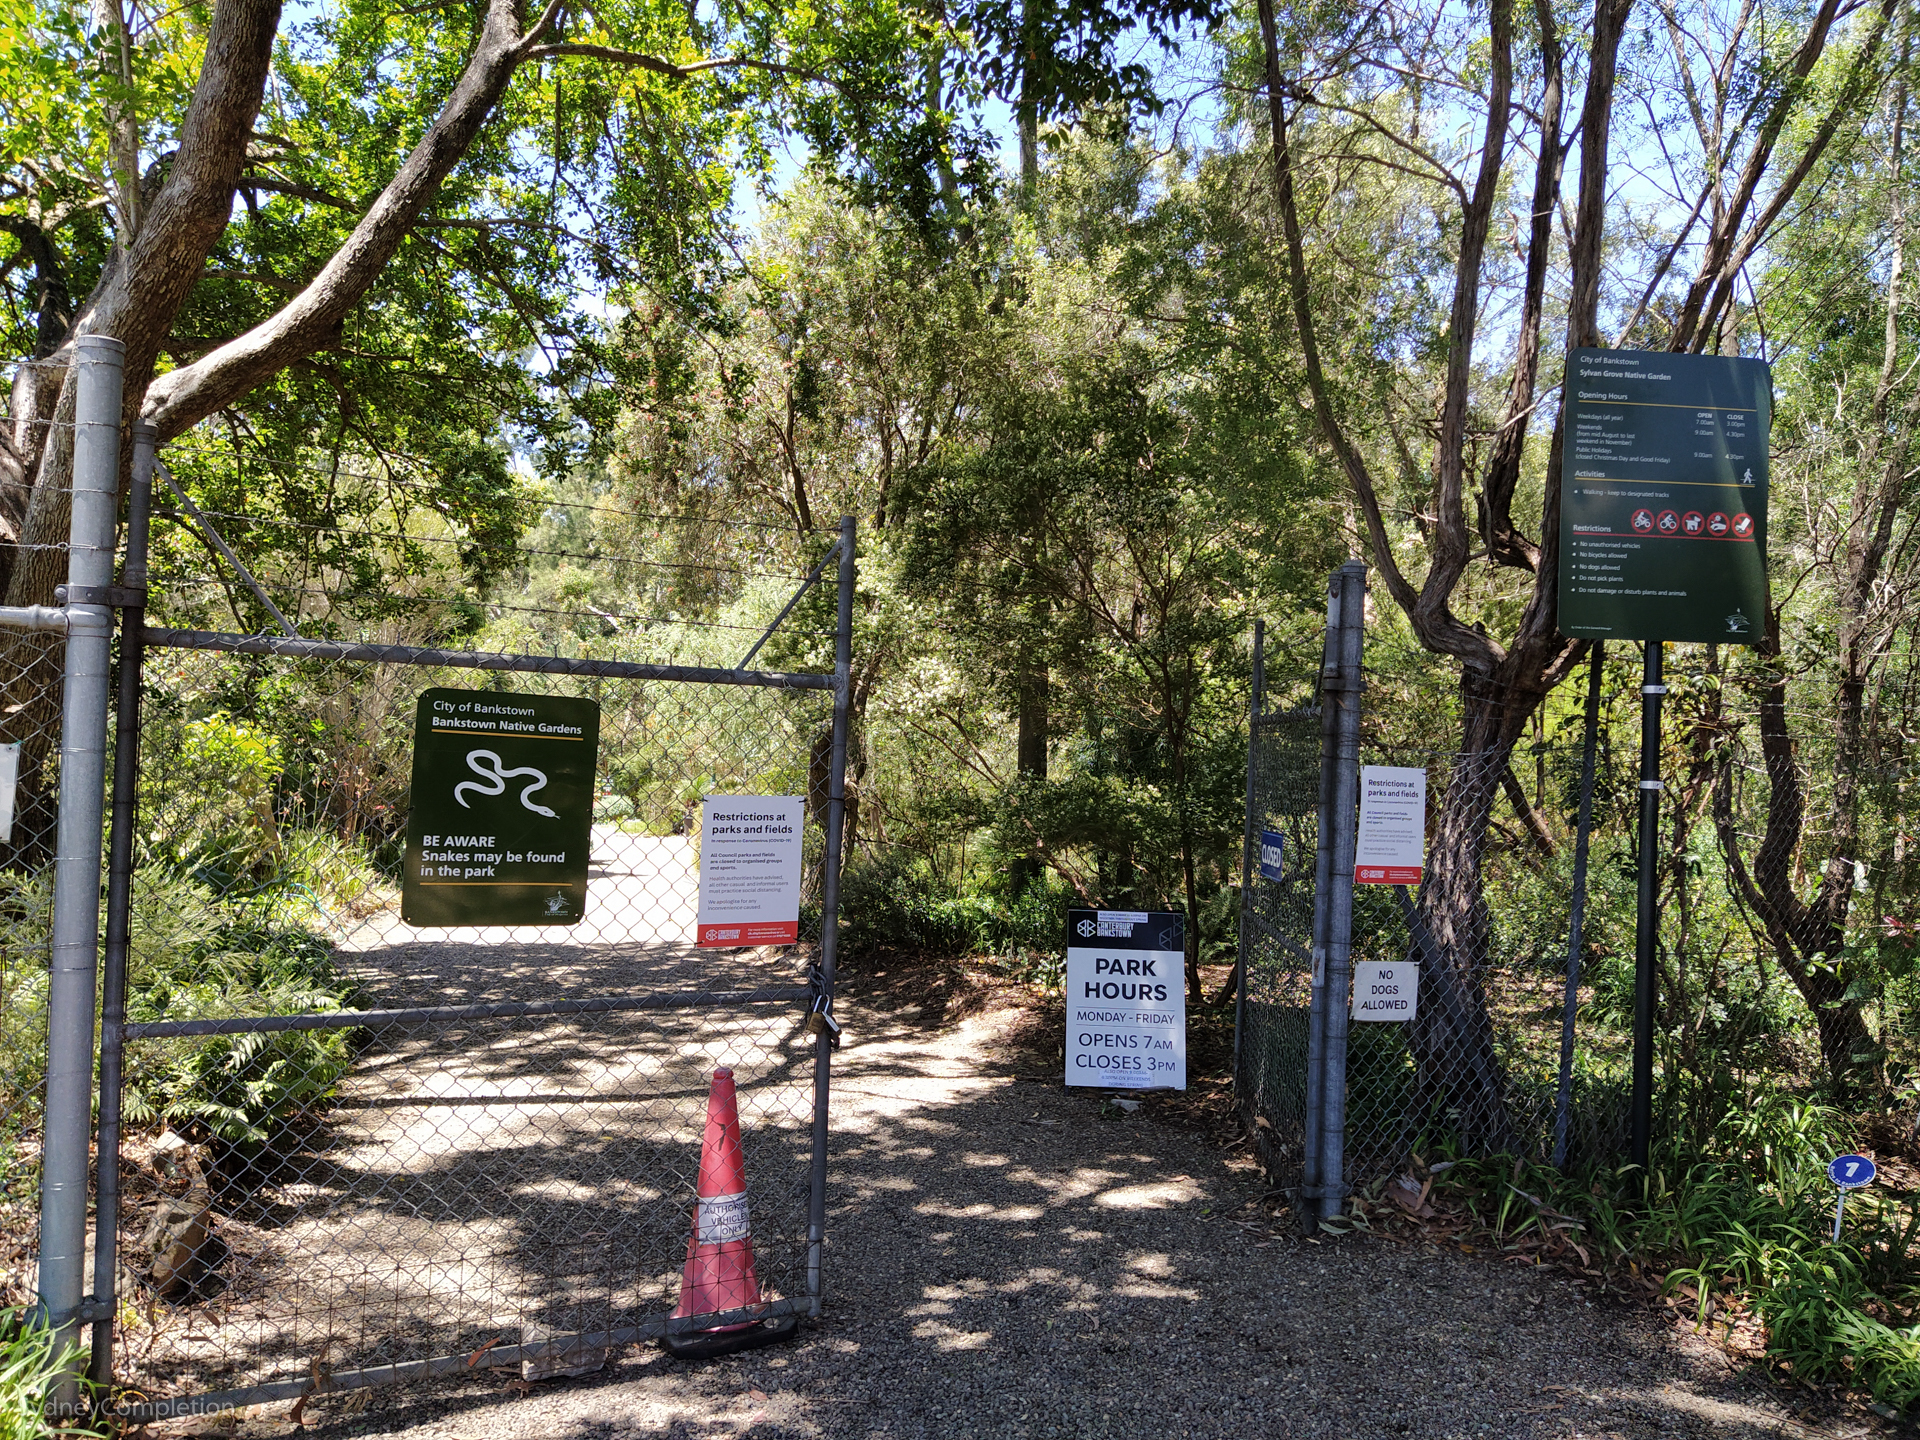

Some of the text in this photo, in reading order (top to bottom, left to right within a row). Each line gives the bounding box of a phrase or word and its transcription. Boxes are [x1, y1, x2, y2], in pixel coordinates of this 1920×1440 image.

[1580, 356, 1593, 364] City
[1580, 369, 1602, 377] Sylvan
[1578, 391, 1607, 400] Opening
[1573, 524, 1611, 532] Restrictions
[433, 700, 535, 716] City of Bankstown
[432, 716, 582, 734] Bankstown Native Gardens
[1368, 779, 1407, 788] Restrictions
[713, 812, 774, 821] Restrictions
[712, 825, 793, 836] parks and fields
[423, 835, 496, 848] BE AWARE
[422, 850, 565, 865] Snakes may be found
[1262, 844, 1281, 868] CLOSED
[421, 865, 495, 879] in the park
[1097, 922, 1134, 930] CANTERBURY
[1097, 929, 1132, 938] BANKSTOWN
[1096, 958, 1157, 977] PARK
[1379, 970, 1394, 980] NO
[1085, 982, 1167, 1001] HOURS
[1372, 985, 1399, 995] DOGS
[1360, 1000, 1408, 1010] ALLOWED
[1076, 1011, 1127, 1022] MONDAY
[1136, 1013, 1175, 1024] FRIDAY
[1079, 1033, 1138, 1048] OPENS
[1076, 1054, 1142, 1070] CLOSES
[722, 1224, 743, 1235] ONLY
